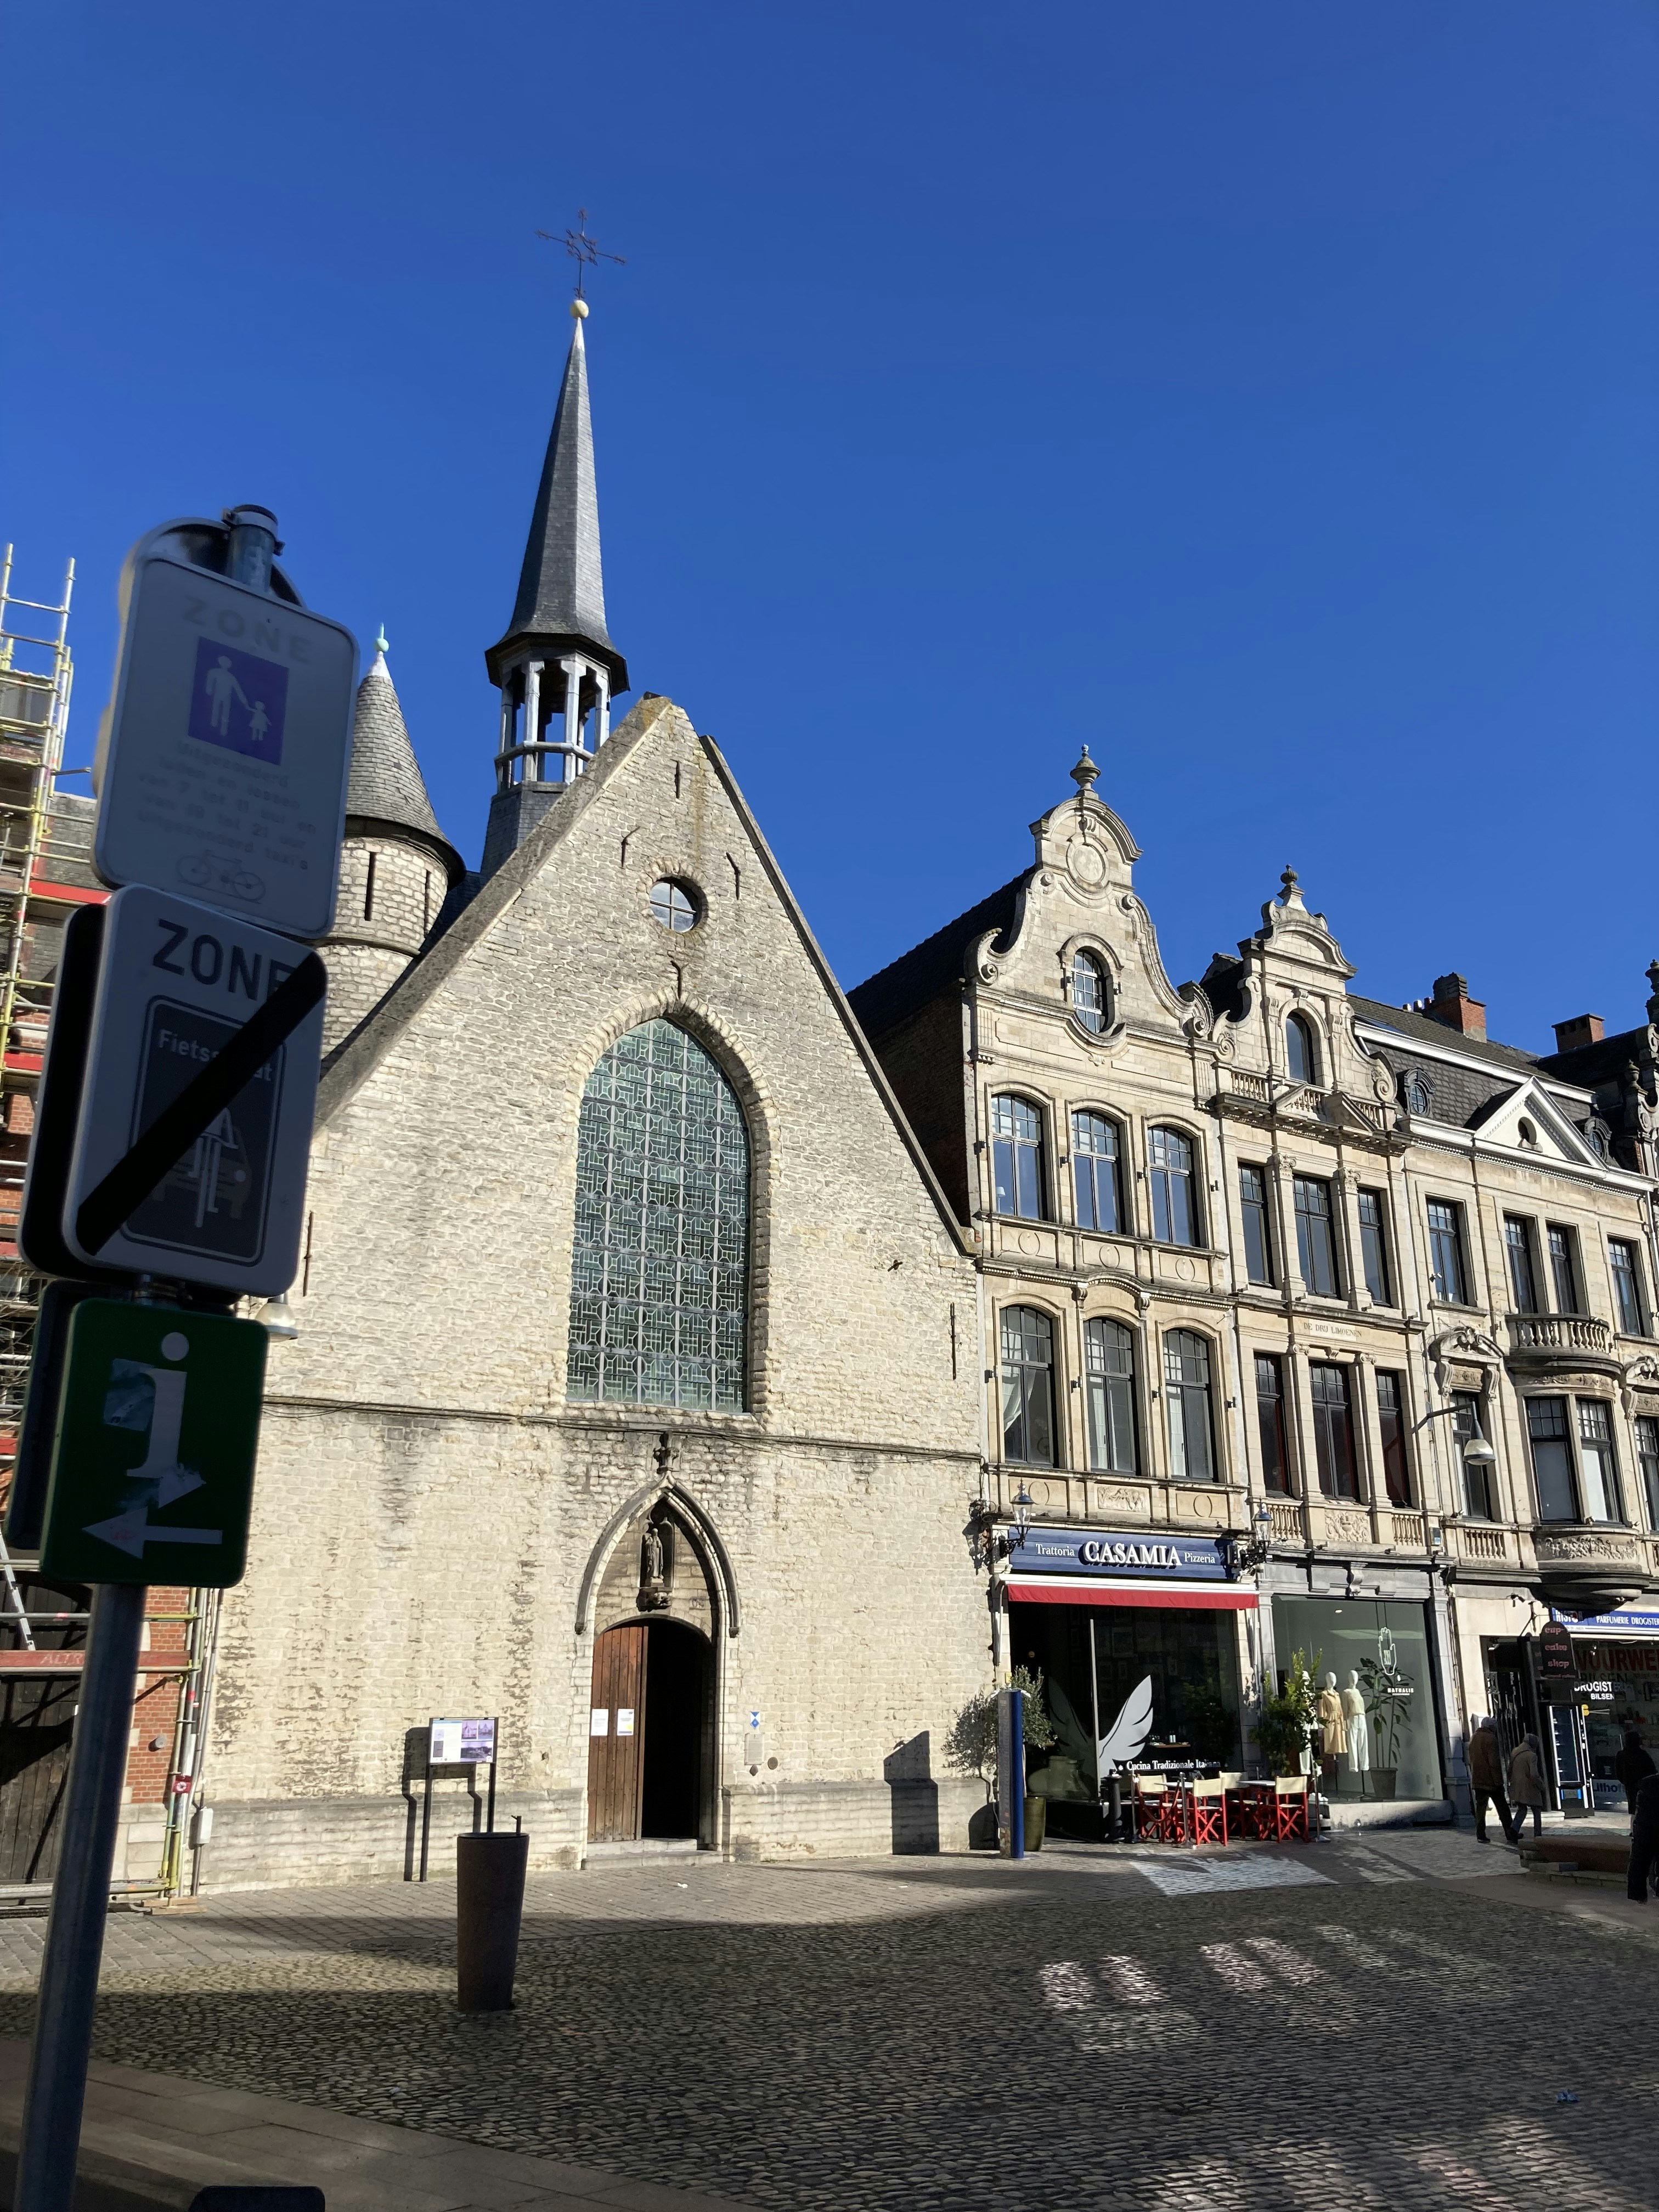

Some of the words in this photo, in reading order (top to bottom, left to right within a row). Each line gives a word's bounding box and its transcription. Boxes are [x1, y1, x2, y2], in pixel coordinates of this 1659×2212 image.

[182, 595, 312, 664] ZONE
[179, 780, 190, 794] 7
[247, 784, 300, 810] lossen
[251, 822, 268, 838] 21
[152, 918, 298, 1004] ZONE
[159, 1029, 272, 1082] Fietsat
[1304, 1322, 1312, 1330] DE
[1035, 1543, 1075, 1557] Trattoria
[1084, 1541, 1183, 1566] CASAMIA
[1184, 1551, 1216, 1564] Pizzeria
[1596, 1615, 1629, 1624] PARFUMERIE
[1545, 1643, 1567, 1651] cake
[1548, 1658, 1570, 1669] shop
[1574, 1649, 1659, 1671] VUURWE
[1126, 1760, 1151, 1770] Cucina
[1152, 1759, 1194, 1770] Tradizionale
[1195, 1759, 1221, 1768] Italiana
